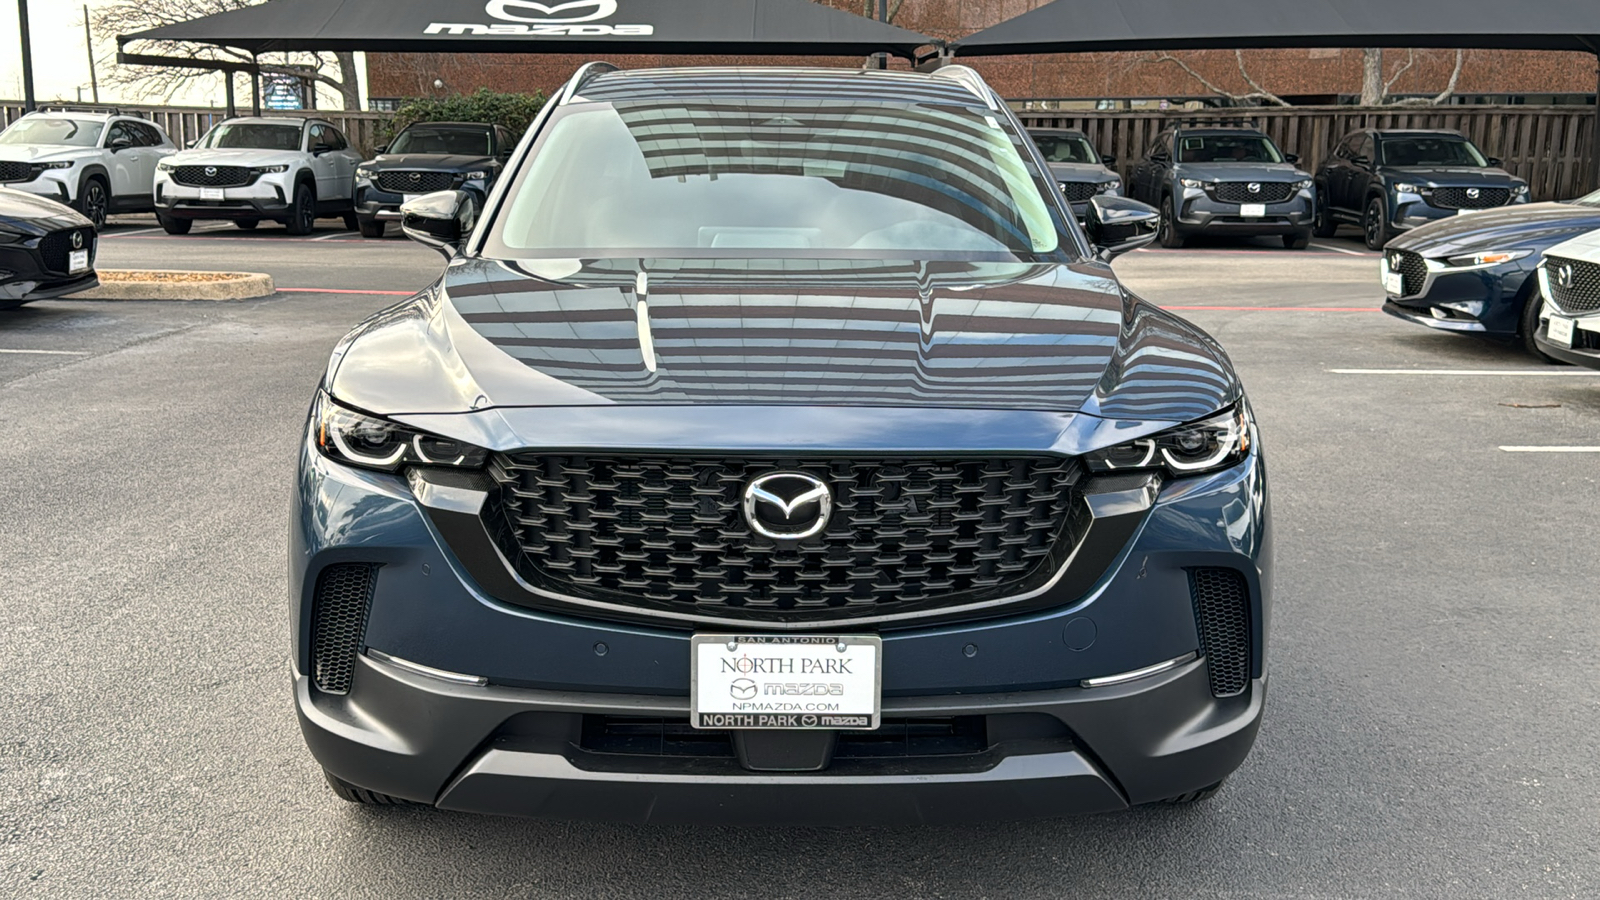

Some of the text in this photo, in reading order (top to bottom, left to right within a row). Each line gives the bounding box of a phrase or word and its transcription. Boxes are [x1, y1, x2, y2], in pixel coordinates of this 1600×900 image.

[423, 22, 654, 36] mazda
[737, 636, 836, 644] SAN ANTONIO
[720, 657, 853, 674] NORTH PARK
[764, 682, 844, 696] mazda
[732, 702, 839, 711] NPMAZDA.COM
[703, 714, 868, 726] NORTH PARK mazda
